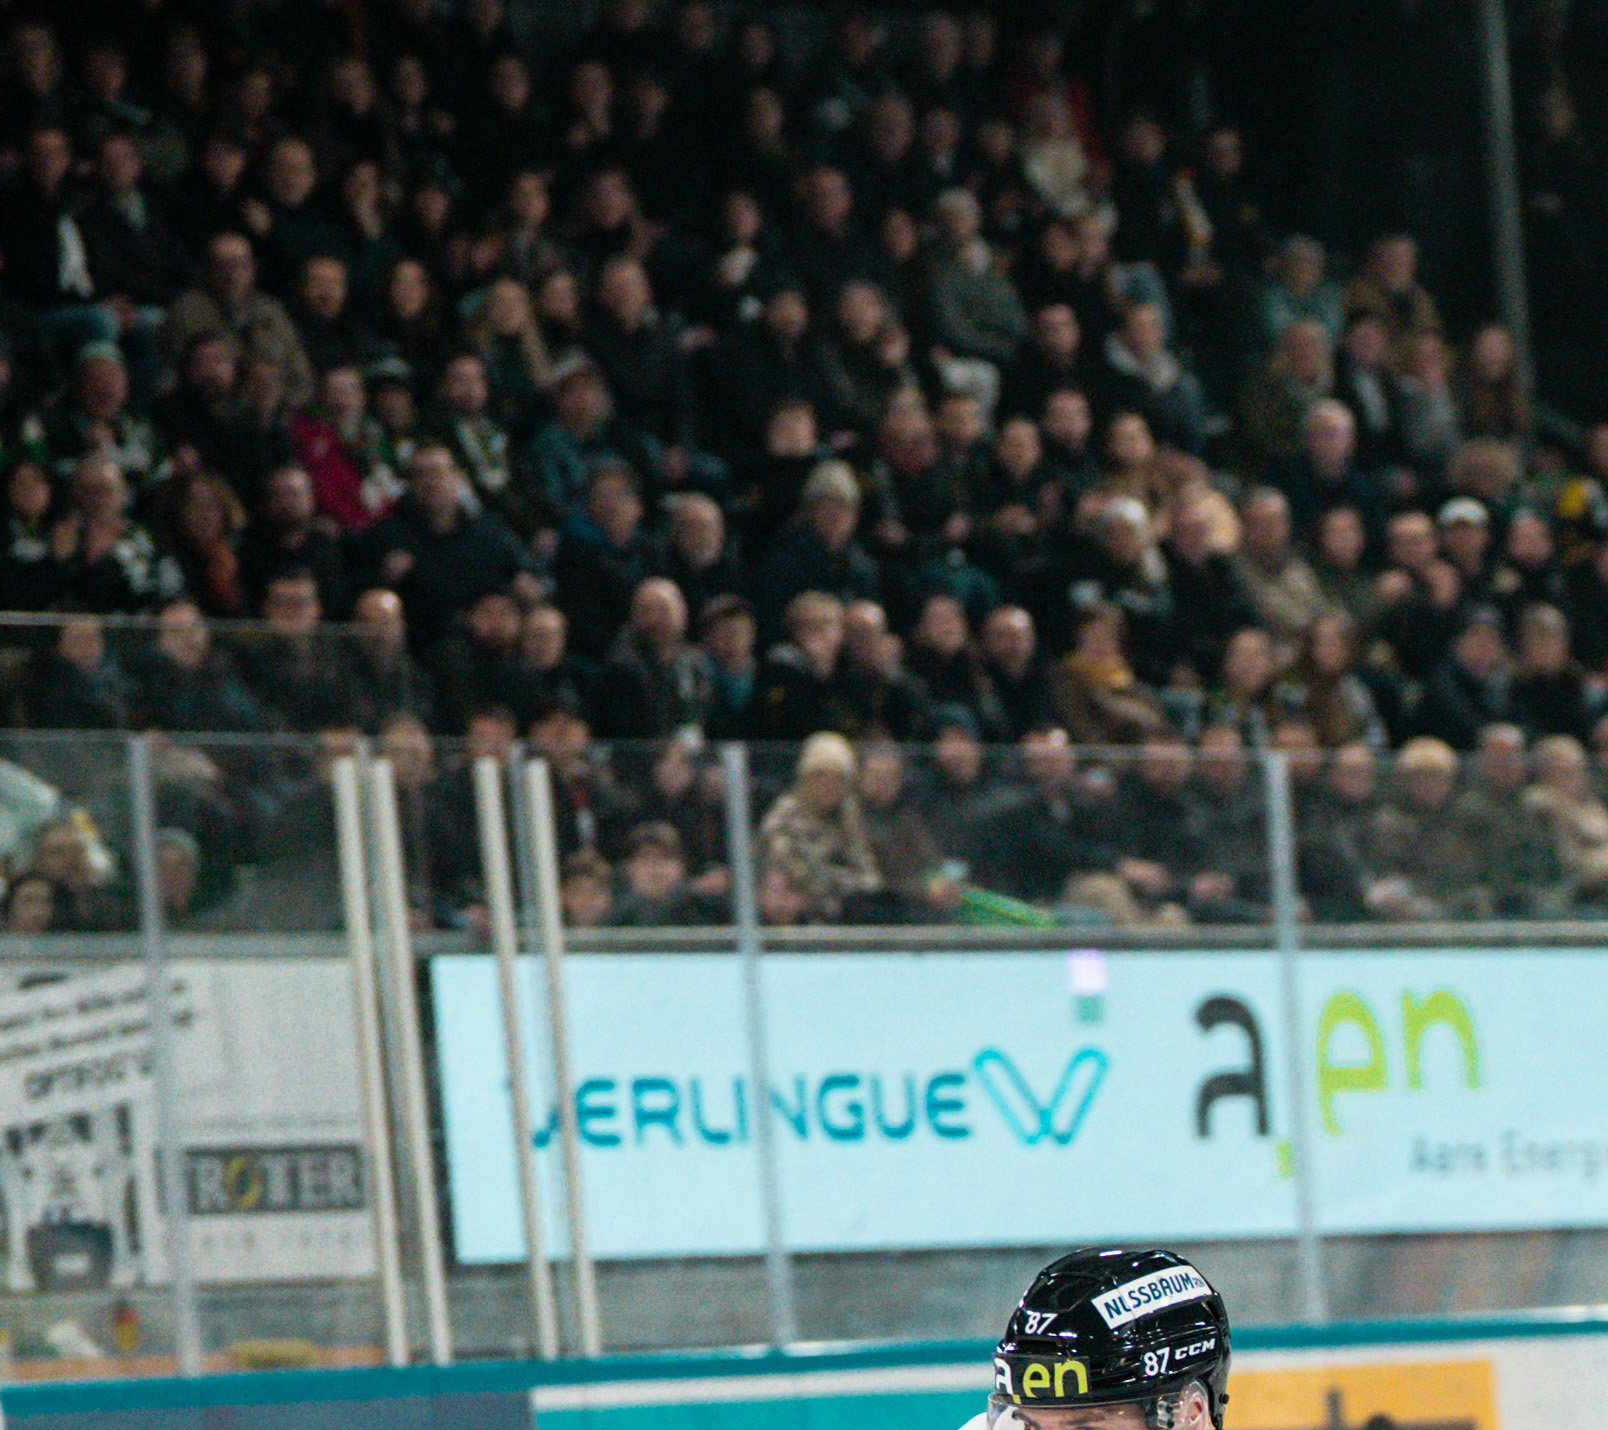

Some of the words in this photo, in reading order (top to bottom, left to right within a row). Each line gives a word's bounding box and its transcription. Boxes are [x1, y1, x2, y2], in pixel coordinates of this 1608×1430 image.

[1024, 1311, 1058, 1335] 87
[1143, 1347, 1171, 1377] 87
[1174, 1338, 1216, 1361] CCM
